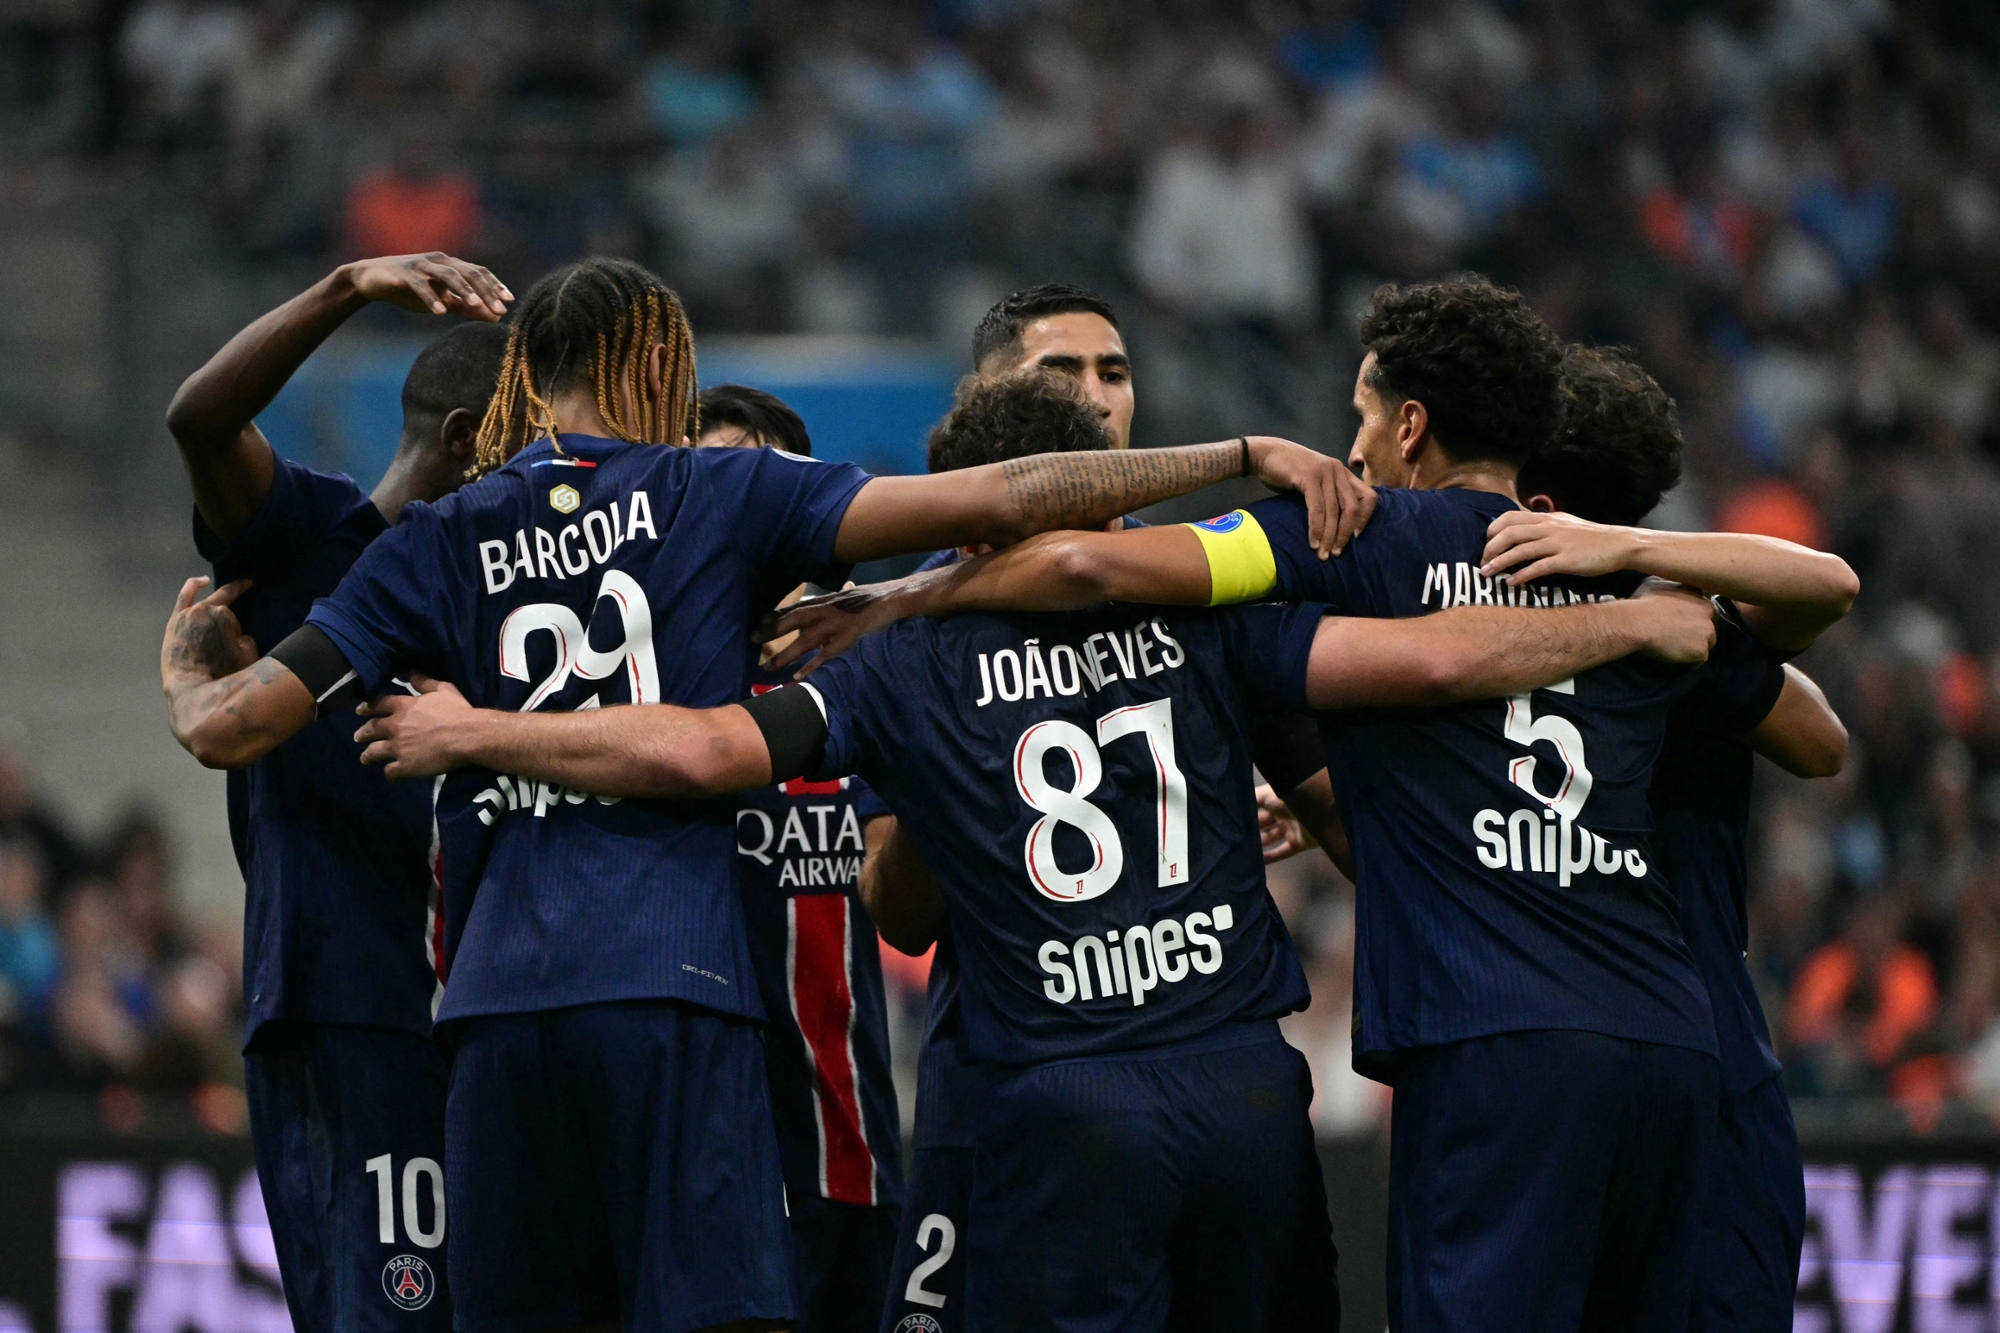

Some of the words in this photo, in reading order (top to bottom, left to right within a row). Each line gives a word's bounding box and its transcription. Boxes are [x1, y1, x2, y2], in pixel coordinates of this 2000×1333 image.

[479, 491, 658, 594] BARCOLA
[499, 569, 660, 712] 29
[976, 638, 1080, 707] JOÃO
[1504, 676, 1593, 820] 5
[1013, 697, 1189, 901] 87
[778, 856, 865, 888] AIRWA
[1038, 909, 1225, 1006] snipes
[366, 1153, 446, 1249] 10
[388, 1257, 425, 1272] PARIS
[904, 1213, 956, 1309] 2
[903, 1316, 937, 1332] PARIS
